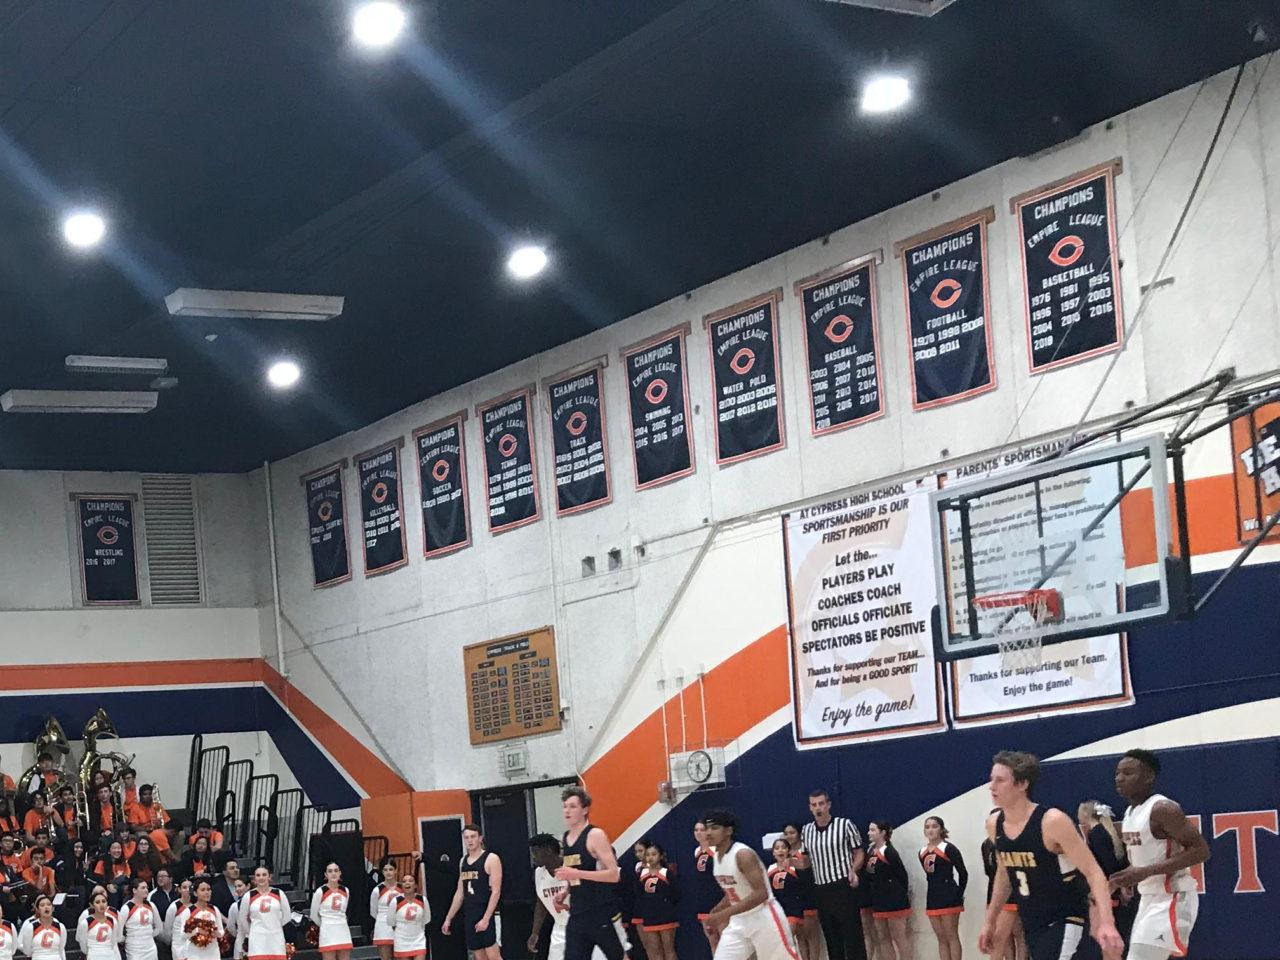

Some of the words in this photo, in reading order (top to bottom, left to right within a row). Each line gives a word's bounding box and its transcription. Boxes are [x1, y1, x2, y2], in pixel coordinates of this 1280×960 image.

[1035, 187, 1094, 219] CHAMPIONS
[1028, 220, 1060, 248] EMPIRE
[1069, 214, 1105, 226] LEAGUE
[912, 232, 973, 265] CHAMPIONS
[813, 275, 860, 302] CHAMPIONS
[910, 264, 939, 292] EMPIRE
[943, 260, 978, 272] LEAGUE
[1042, 263, 1095, 289] BASKETBALL
[718, 309, 765, 336] CHAMPIONS
[810, 301, 835, 324] EMPIRE
[839, 295, 866, 307] LEAGUE
[927, 309, 967, 330] FOOTBALL
[634, 344, 673, 367] CHAMPIONS
[718, 334, 740, 356] EMPIRE
[743, 329, 769, 341] LEAGUE
[825, 345, 857, 363] BASEBALL
[940, 340, 960, 354] 2011
[554, 375, 594, 398] CHAMPIONS
[632, 366, 653, 388] EMPIRE
[655, 362, 677, 373] LEAGUE
[723, 382, 744, 395] WATER
[750, 374, 766, 387] POLO
[486, 401, 521, 423] CHAMPIONS
[421, 427, 455, 448] CHAMPIONS
[362, 452, 393, 471] CHAMPIONS
[956, 456, 1002, 479] PARENTS'
[87, 502, 124, 511] CHAMPIONS
[800, 507, 809, 519] AT
[811, 498, 848, 517] CYPRESS
[850, 492, 870, 507] HIGH
[872, 484, 906, 502] SCHOOL
[803, 509, 876, 533] SPORTSMANSHIP
[879, 504, 888, 515] IS
[890, 499, 909, 512] OUR
[822, 527, 846, 544] FIRST
[849, 518, 890, 540] PRIORITY
[836, 552, 855, 566] Let
[822, 570, 865, 590] PLAYERS
[868, 563, 894, 581] PLAY
[819, 591, 864, 610] COACHES
[867, 583, 901, 601] COACH
[811, 612, 860, 632] OFFICIALS
[863, 602, 912, 623] OFFICIATE
[802, 632, 862, 654] SPECTATORS
[865, 628, 878, 641] BE
[880, 621, 926, 640] POSITIVE
[807, 665, 831, 677] Thanks
[833, 663, 842, 673] for
[845, 655, 881, 672] supporting
[884, 655, 896, 664] our
[815, 678, 828, 689] And
[830, 676, 840, 686] for
[842, 673, 860, 686] being
[869, 669, 889, 680] GOOD
[891, 663, 918, 676] SPORT!
[969, 668, 998, 683] Thanks
[1000, 667, 1012, 678] for
[1016, 660, 1061, 677] supporting
[1064, 657, 1079, 668] our
[1082, 653, 1107, 665] Team.
[1003, 685, 1026, 698] Enjoy
[1029, 682, 1043, 692] the
[1046, 677, 1073, 691] game!
[822, 706, 852, 728] Enjoy
[855, 701, 872, 716] the
[875, 695, 915, 721] game!
